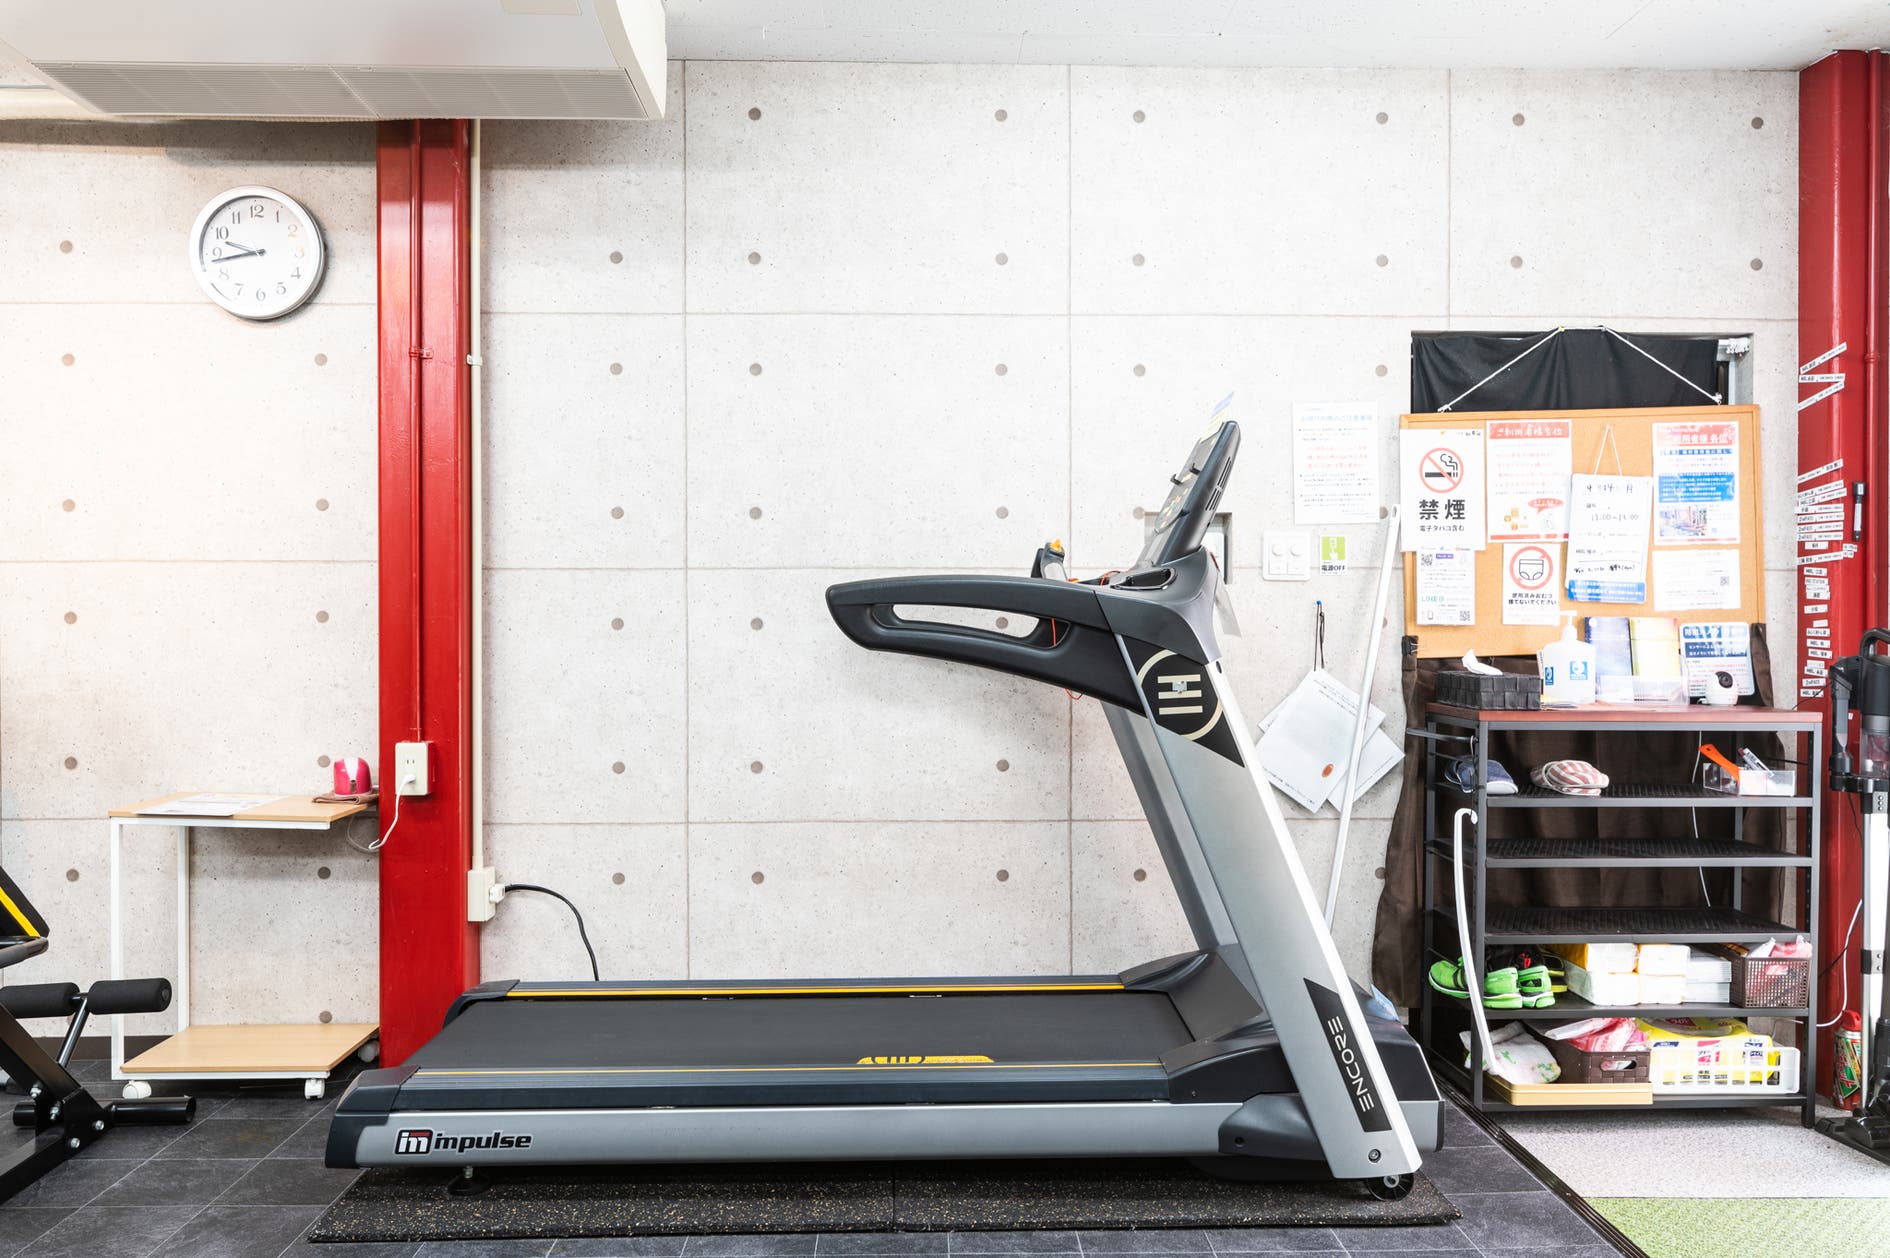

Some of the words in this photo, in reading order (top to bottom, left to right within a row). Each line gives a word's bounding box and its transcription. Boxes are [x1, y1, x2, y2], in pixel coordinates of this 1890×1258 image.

[232, 211, 241, 224] 11
[250, 205, 264, 218] 12
[276, 209, 280, 223] 1
[216, 226, 229, 240] 10
[288, 224, 298, 237] 2
[212, 247, 222, 260] 9
[295, 246, 305, 258] 3
[219, 267, 230, 280] 8
[291, 266, 301, 279] 4
[235, 283, 244, 296] 7
[256, 288, 266, 301] 6
[276, 282, 287, 295] 5
[1418, 499, 1466, 520] 禁煙
[1419, 524, 1465, 532] 電子タバコ含む
[1327, 1016, 1375, 1113] ENCORE
[434, 1132, 532, 1153] impulse
